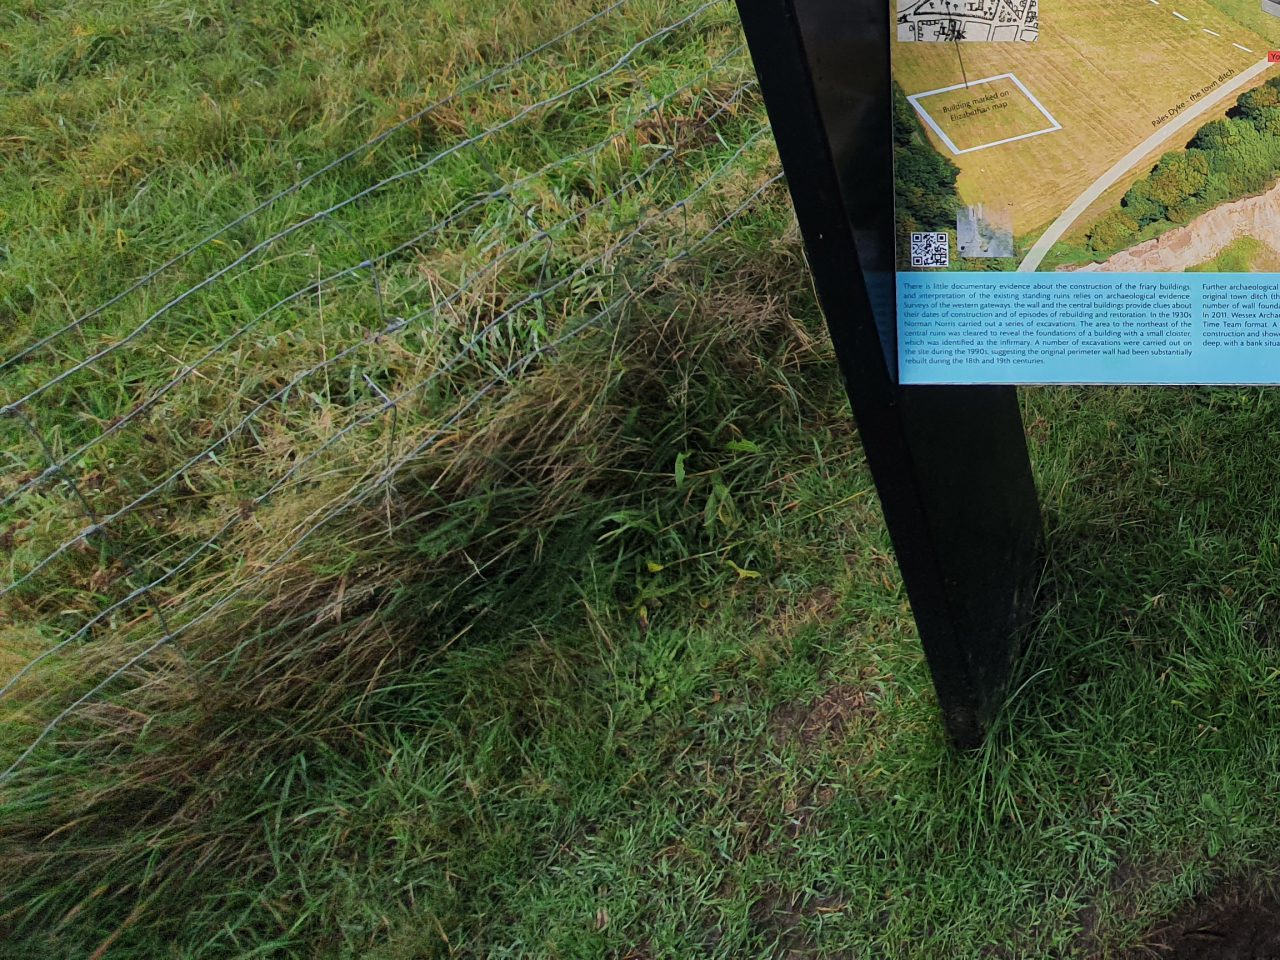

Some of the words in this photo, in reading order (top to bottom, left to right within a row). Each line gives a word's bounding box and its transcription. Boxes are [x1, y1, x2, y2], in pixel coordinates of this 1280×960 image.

[942, 102, 972, 113] Building
[972, 92, 998, 105] marked
[1152, 114, 1168, 127] Pales
[1168, 102, 1185, 116] Dyke
[1189, 92, 1201, 102] the
[1201, 80, 1217, 93] town
[1218, 69, 1235, 82] ditch
[950, 107, 990, 121] Elizabethan
[992, 101, 1008, 110] map
[904, 282, 923, 290] There
[925, 282, 930, 290] is
[1125, 282, 1136, 290] the
[1139, 283, 1157, 291] friary
[1229, 283, 1279, 292] archaeological
